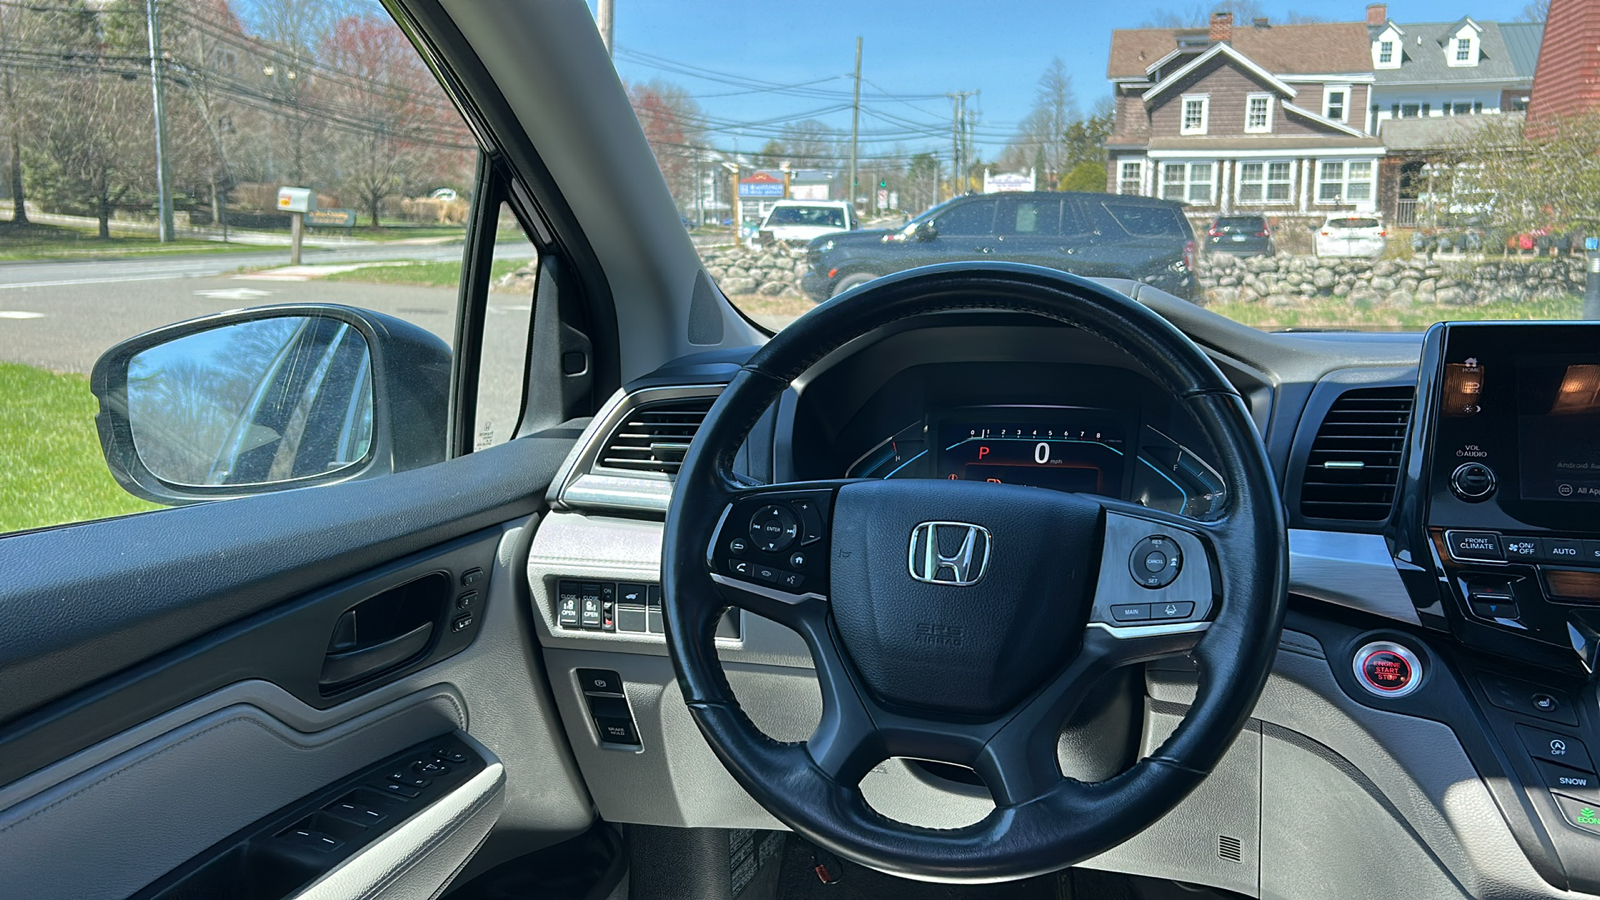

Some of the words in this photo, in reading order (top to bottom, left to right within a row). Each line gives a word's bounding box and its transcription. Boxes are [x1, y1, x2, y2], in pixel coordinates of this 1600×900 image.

[978, 446, 990, 460] P
[1034, 442, 1050, 464] 0
[1460, 542, 1494, 550] CLIMATE
[1552, 548, 1577, 556] AUTO
[1375, 666, 1399, 674] START
[1559, 777, 1587, 786] SNOW
[1577, 816, 1600, 825] ECON
